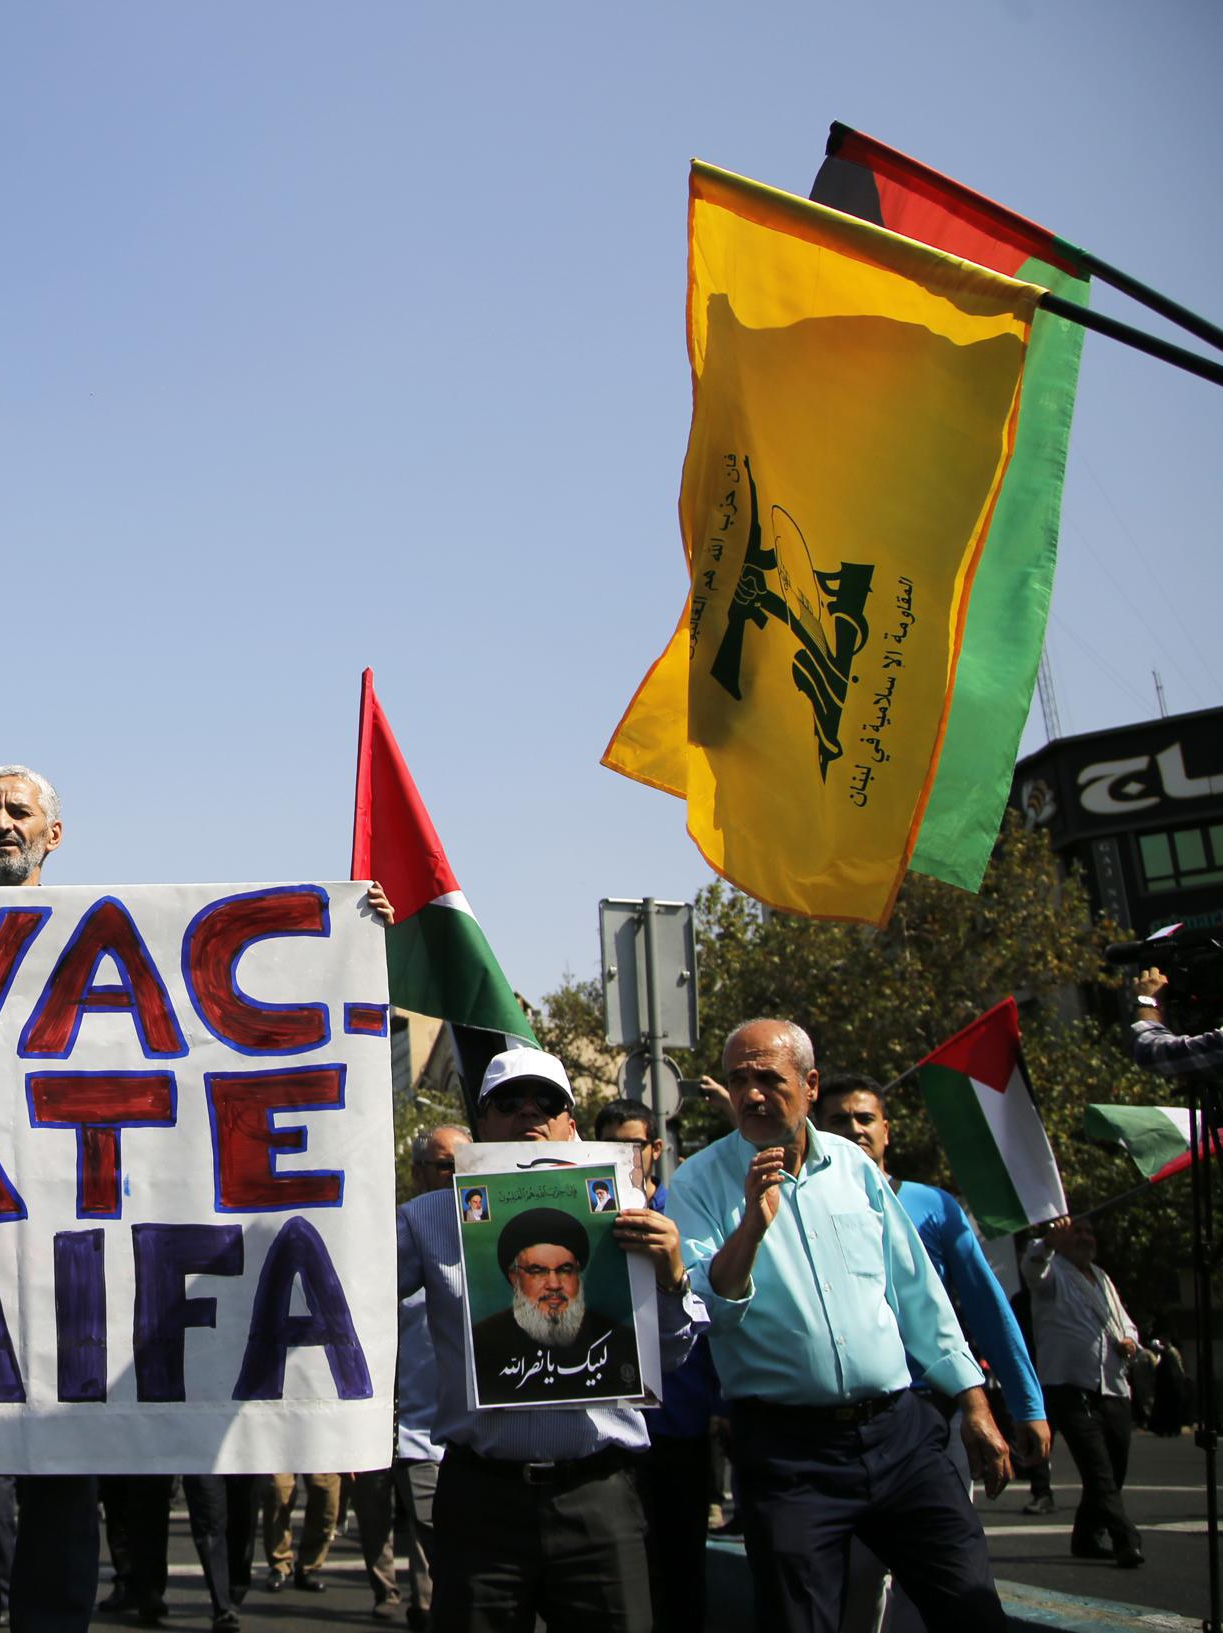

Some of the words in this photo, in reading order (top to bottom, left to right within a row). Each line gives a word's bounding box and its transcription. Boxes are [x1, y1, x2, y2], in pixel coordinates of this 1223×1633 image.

[719, 490, 738, 531] حزب
[708, 538, 725, 562] الله
[703, 570, 720, 591] هم
[883, 576, 916, 644] المقاومة
[860, 736, 890, 763] في
[849, 764, 875, 808] لبنان
